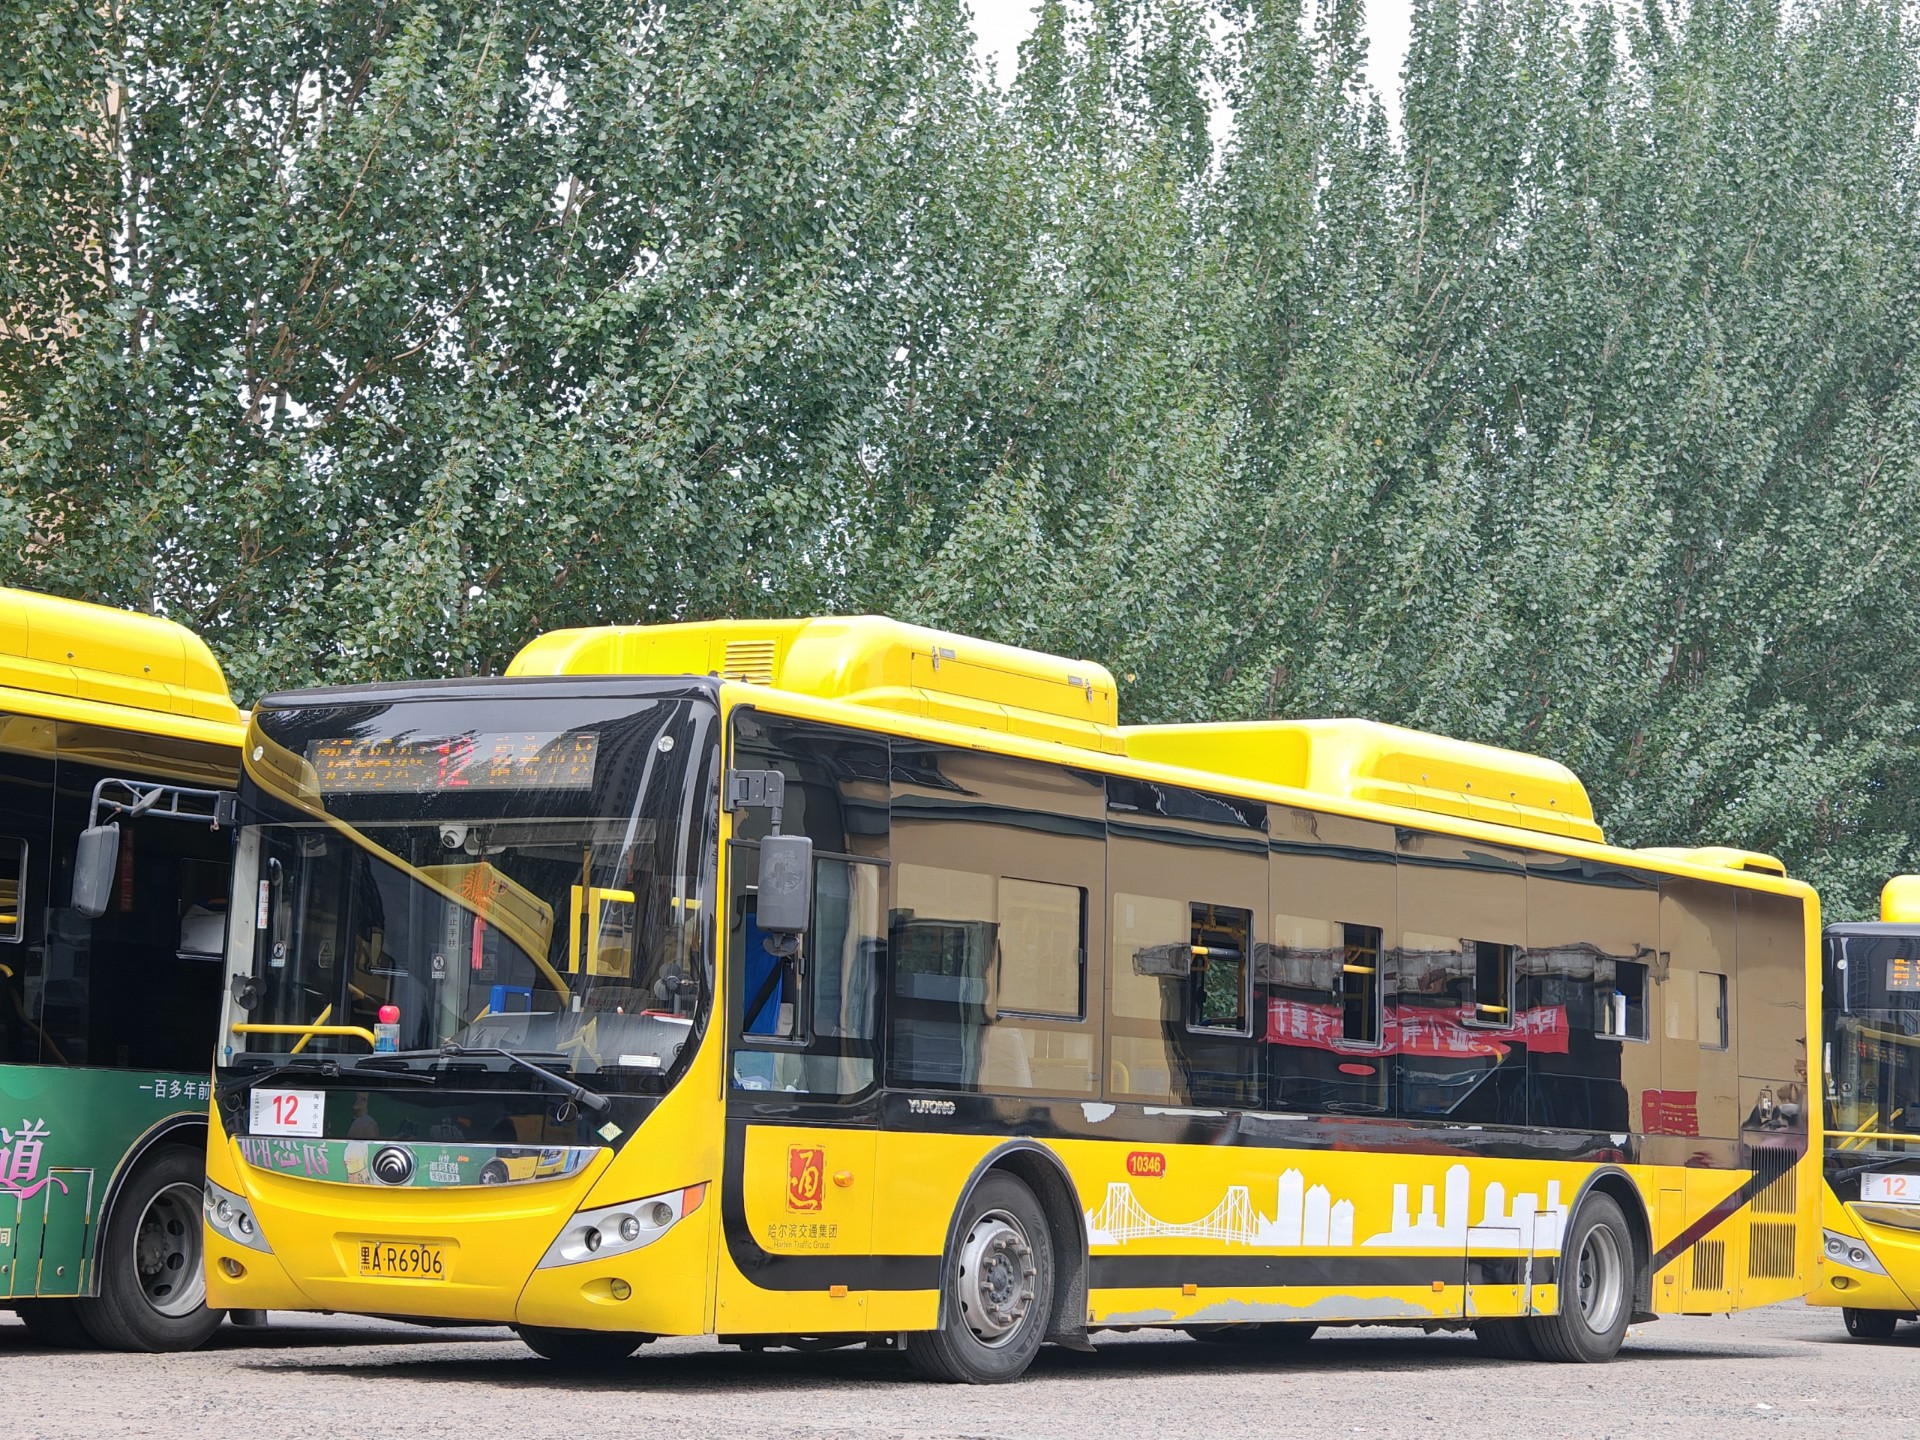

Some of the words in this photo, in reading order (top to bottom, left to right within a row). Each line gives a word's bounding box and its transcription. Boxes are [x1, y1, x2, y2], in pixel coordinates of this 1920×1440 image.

[139, 1079, 211, 1101] 一百多年前
[272, 1095, 299, 1125] 12
[908, 1099, 956, 1115] YUTONG
[0, 1118, 64, 1198] 道
[1131, 1155, 1161, 1173] 10346
[1883, 1177, 1906, 1196] 12
[768, 1223, 838, 1239] 哈尔滨交通集团
[794, 1240, 812, 1249] Traffic
[813, 1240, 831, 1250] Group
